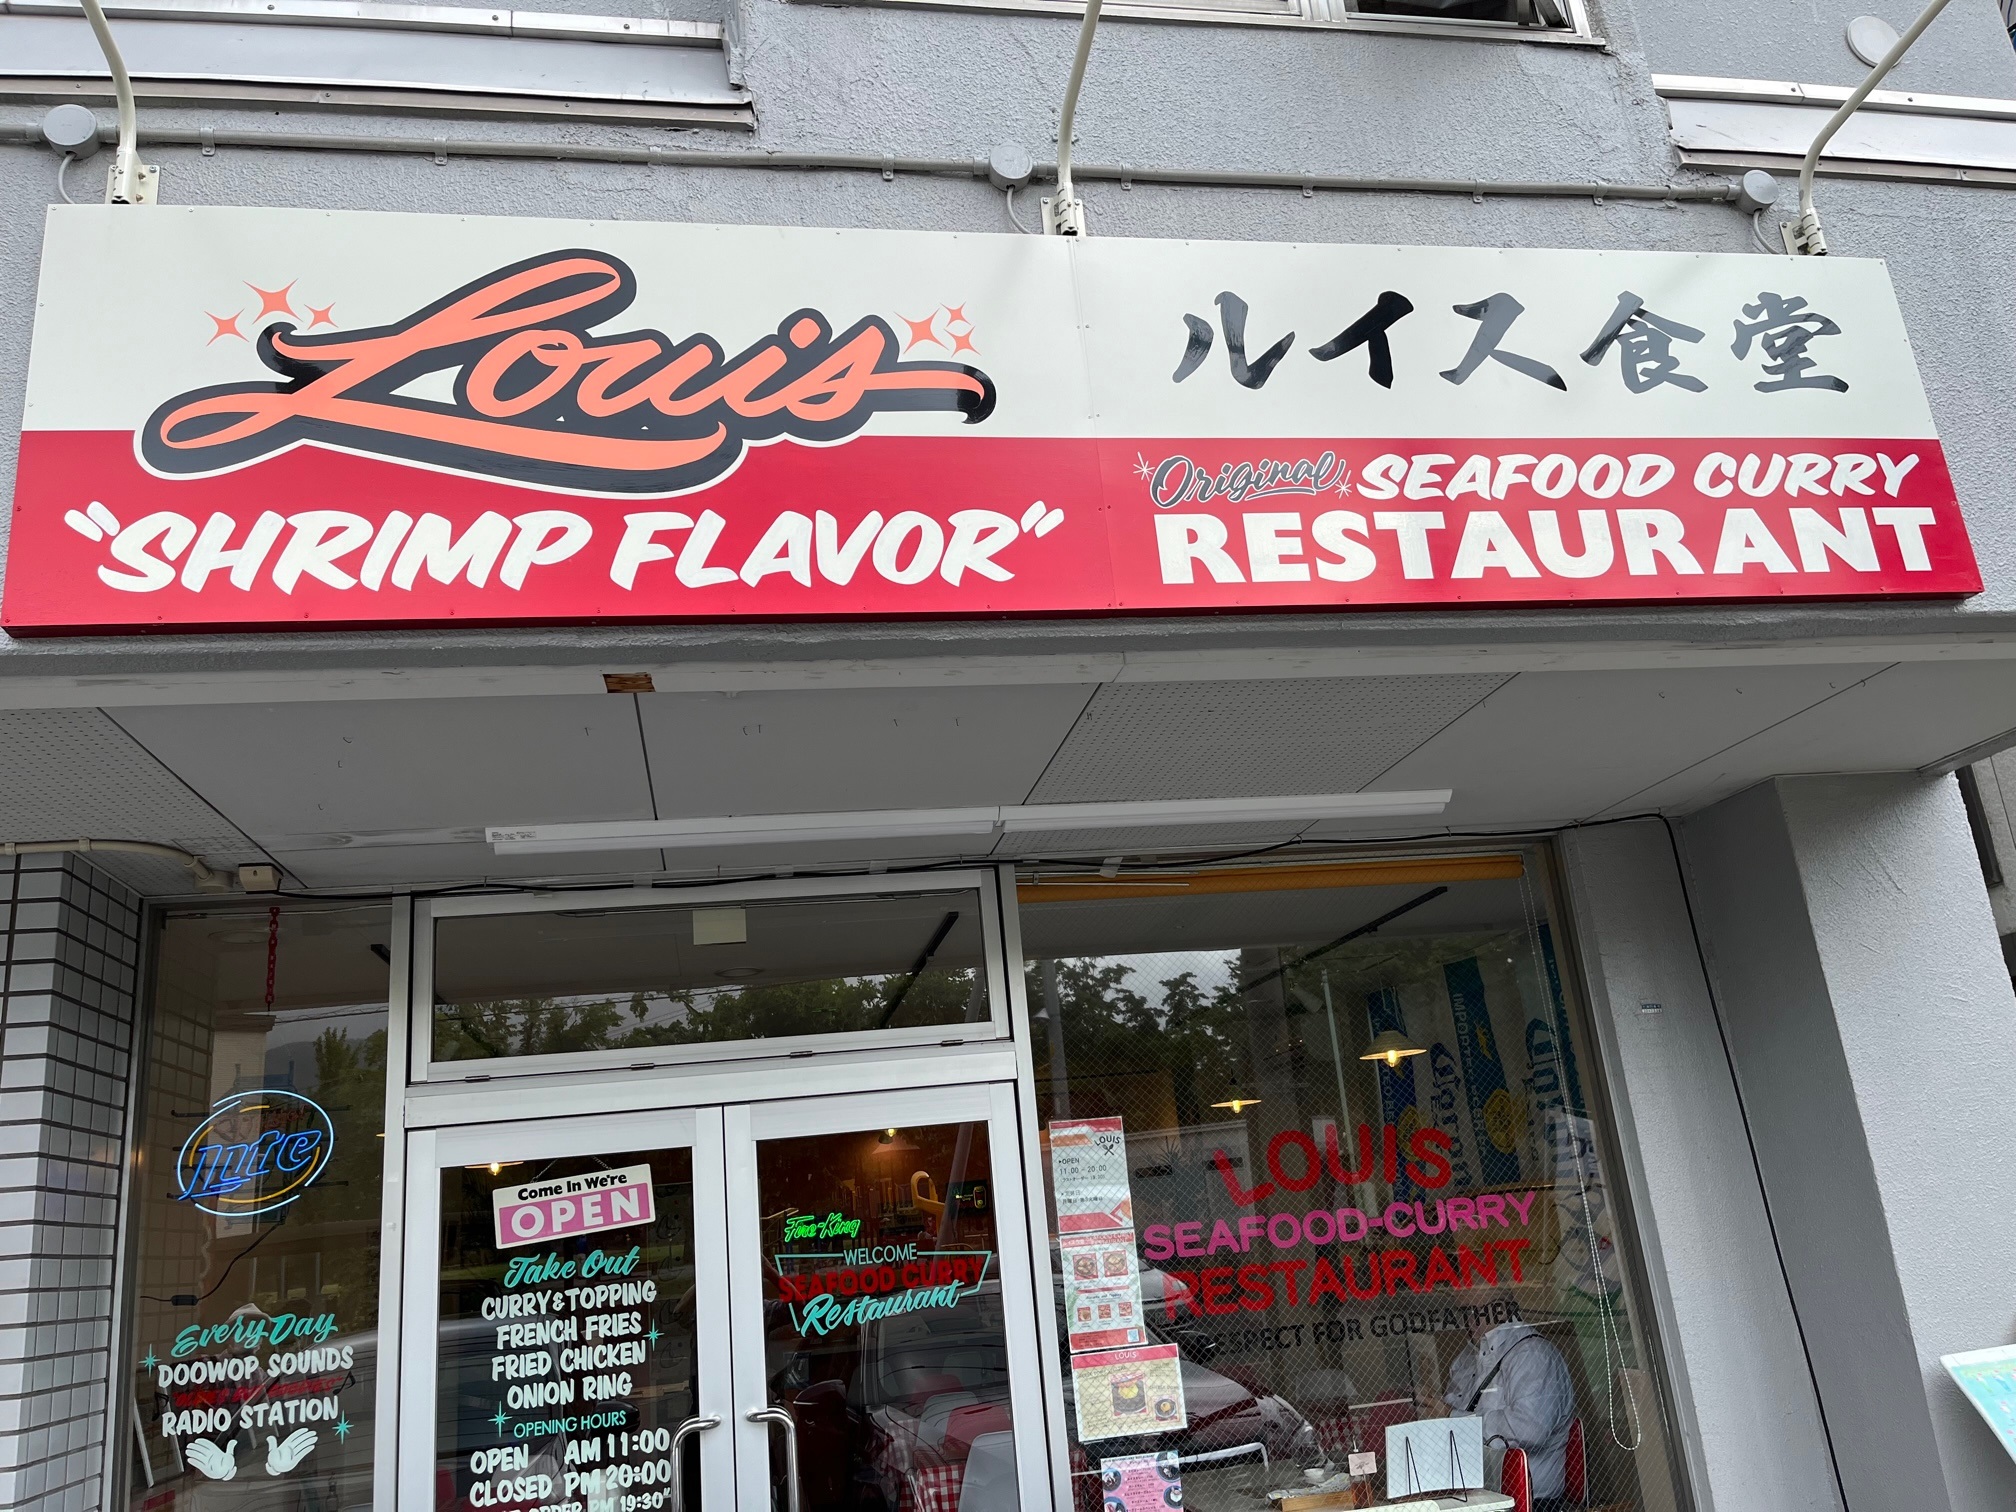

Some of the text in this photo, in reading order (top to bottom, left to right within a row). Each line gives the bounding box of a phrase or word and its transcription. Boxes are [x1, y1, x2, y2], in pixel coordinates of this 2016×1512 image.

[1171, 290, 1851, 394] ルイス食堂
[150, 251, 993, 484] Louis
[1148, 449, 1920, 508] Original SEAFOOD CURRY
[1153, 505, 1937, 585] RESTAURANT
[1094, 1134, 1122, 1147] LOUIS
[517, 1173, 628, 1201] Come In We're
[1213, 1122, 1453, 1208] LOUIS
[510, 1187, 640, 1238] OPEN
[1143, 1190, 1537, 1261] SEAFOOD-CURRY
[503, 1245, 640, 1288] Take Out
[843, 1242, 918, 1266] WELCOME
[778, 1256, 987, 1303] SEAFOOD CURRY
[1162, 1238, 1530, 1320] RESTAURANT
[496, 1311, 642, 1350] FRENCH FRIES
[801, 1279, 965, 1338] Restaurant
[1311, 1317, 1365, 1346] FOR
[1369, 1300, 1523, 1339] GODFATHER
[170, 1312, 339, 1358] Every Day
[1114, 1351, 1138, 1361] LOUIS
[157, 1345, 354, 1389] DOOWOP SOUNDS
[491, 1340, 647, 1382] FRIED CHICKEN
[506, 1371, 633, 1410] ONION RING
[161, 1395, 339, 1438] RADIO STATION
[513, 1410, 627, 1439] OPENING HOURS
[470, 1427, 671, 1475] OPEN AM 11:00
[469, 1458, 671, 1508] CLOSED PM 20:00
